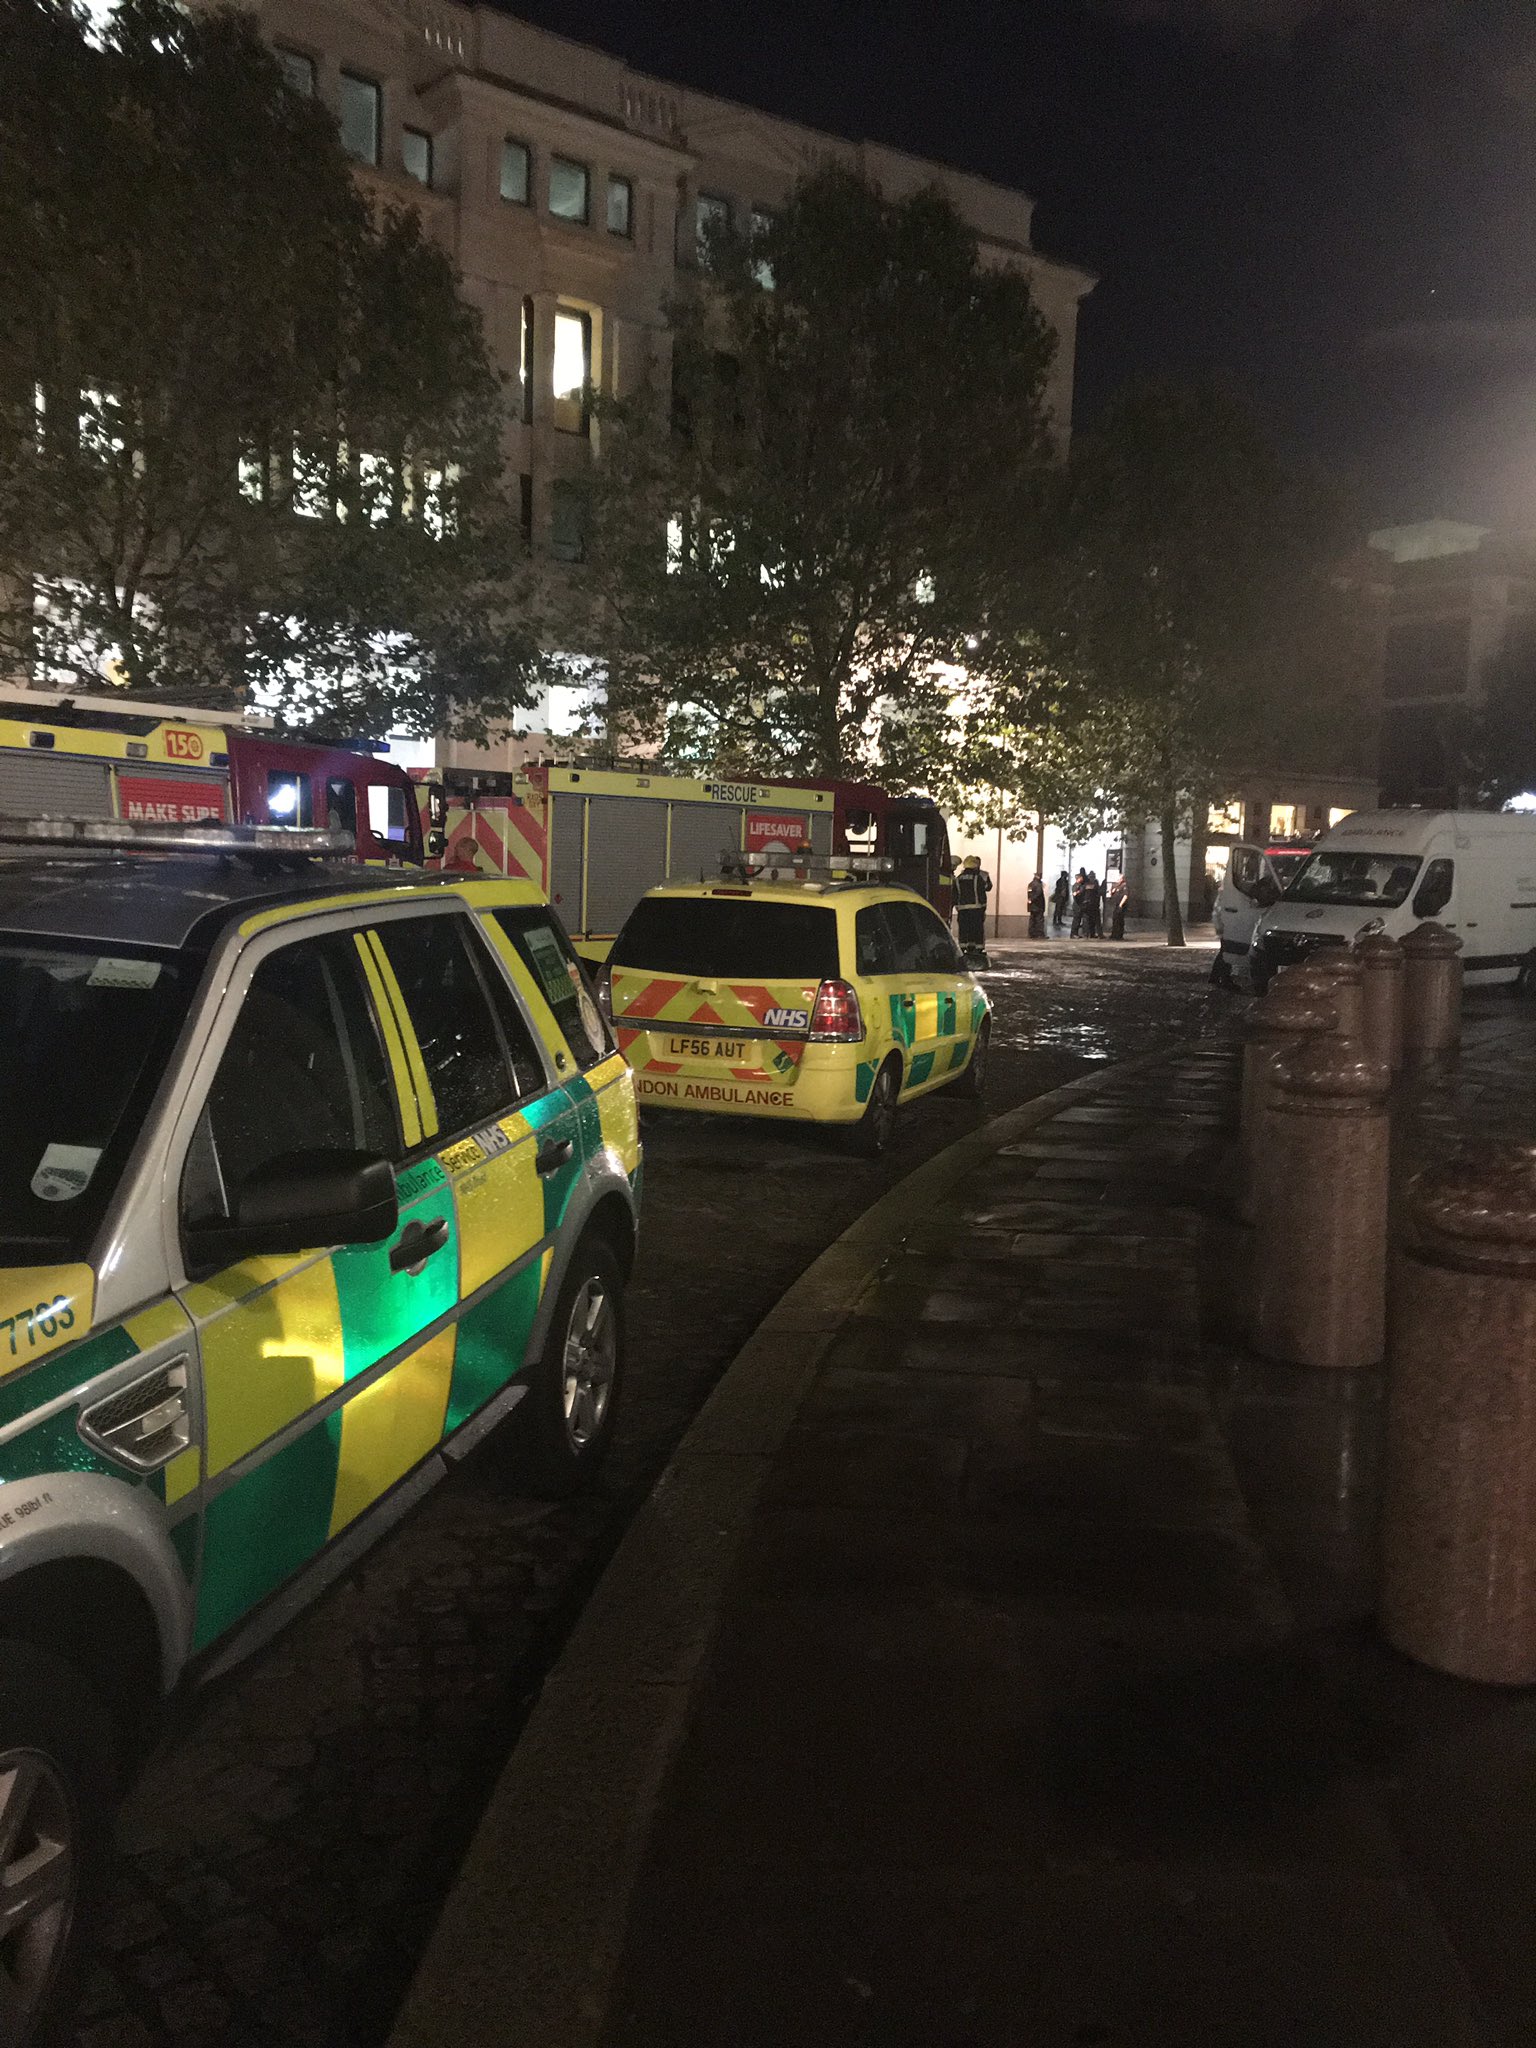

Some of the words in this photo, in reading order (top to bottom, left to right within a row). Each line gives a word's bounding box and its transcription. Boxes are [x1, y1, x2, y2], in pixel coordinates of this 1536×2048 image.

[167, 733, 202, 758] 150
[711, 784, 757, 802] RESCUE
[128, 801, 178, 822] MAKE
[181, 805, 220, 823] SURE
[750, 822, 802, 837] LIFESAVER
[763, 1008, 808, 1028] NHS
[670, 1039, 710, 1056] LF56
[714, 1042, 746, 1058] AUT
[637, 1079, 679, 1097] NDON
[684, 1084, 794, 1107] AMBULANCE
[440, 1146, 481, 1173] Service
[472, 1125, 509, 1156] NHS
